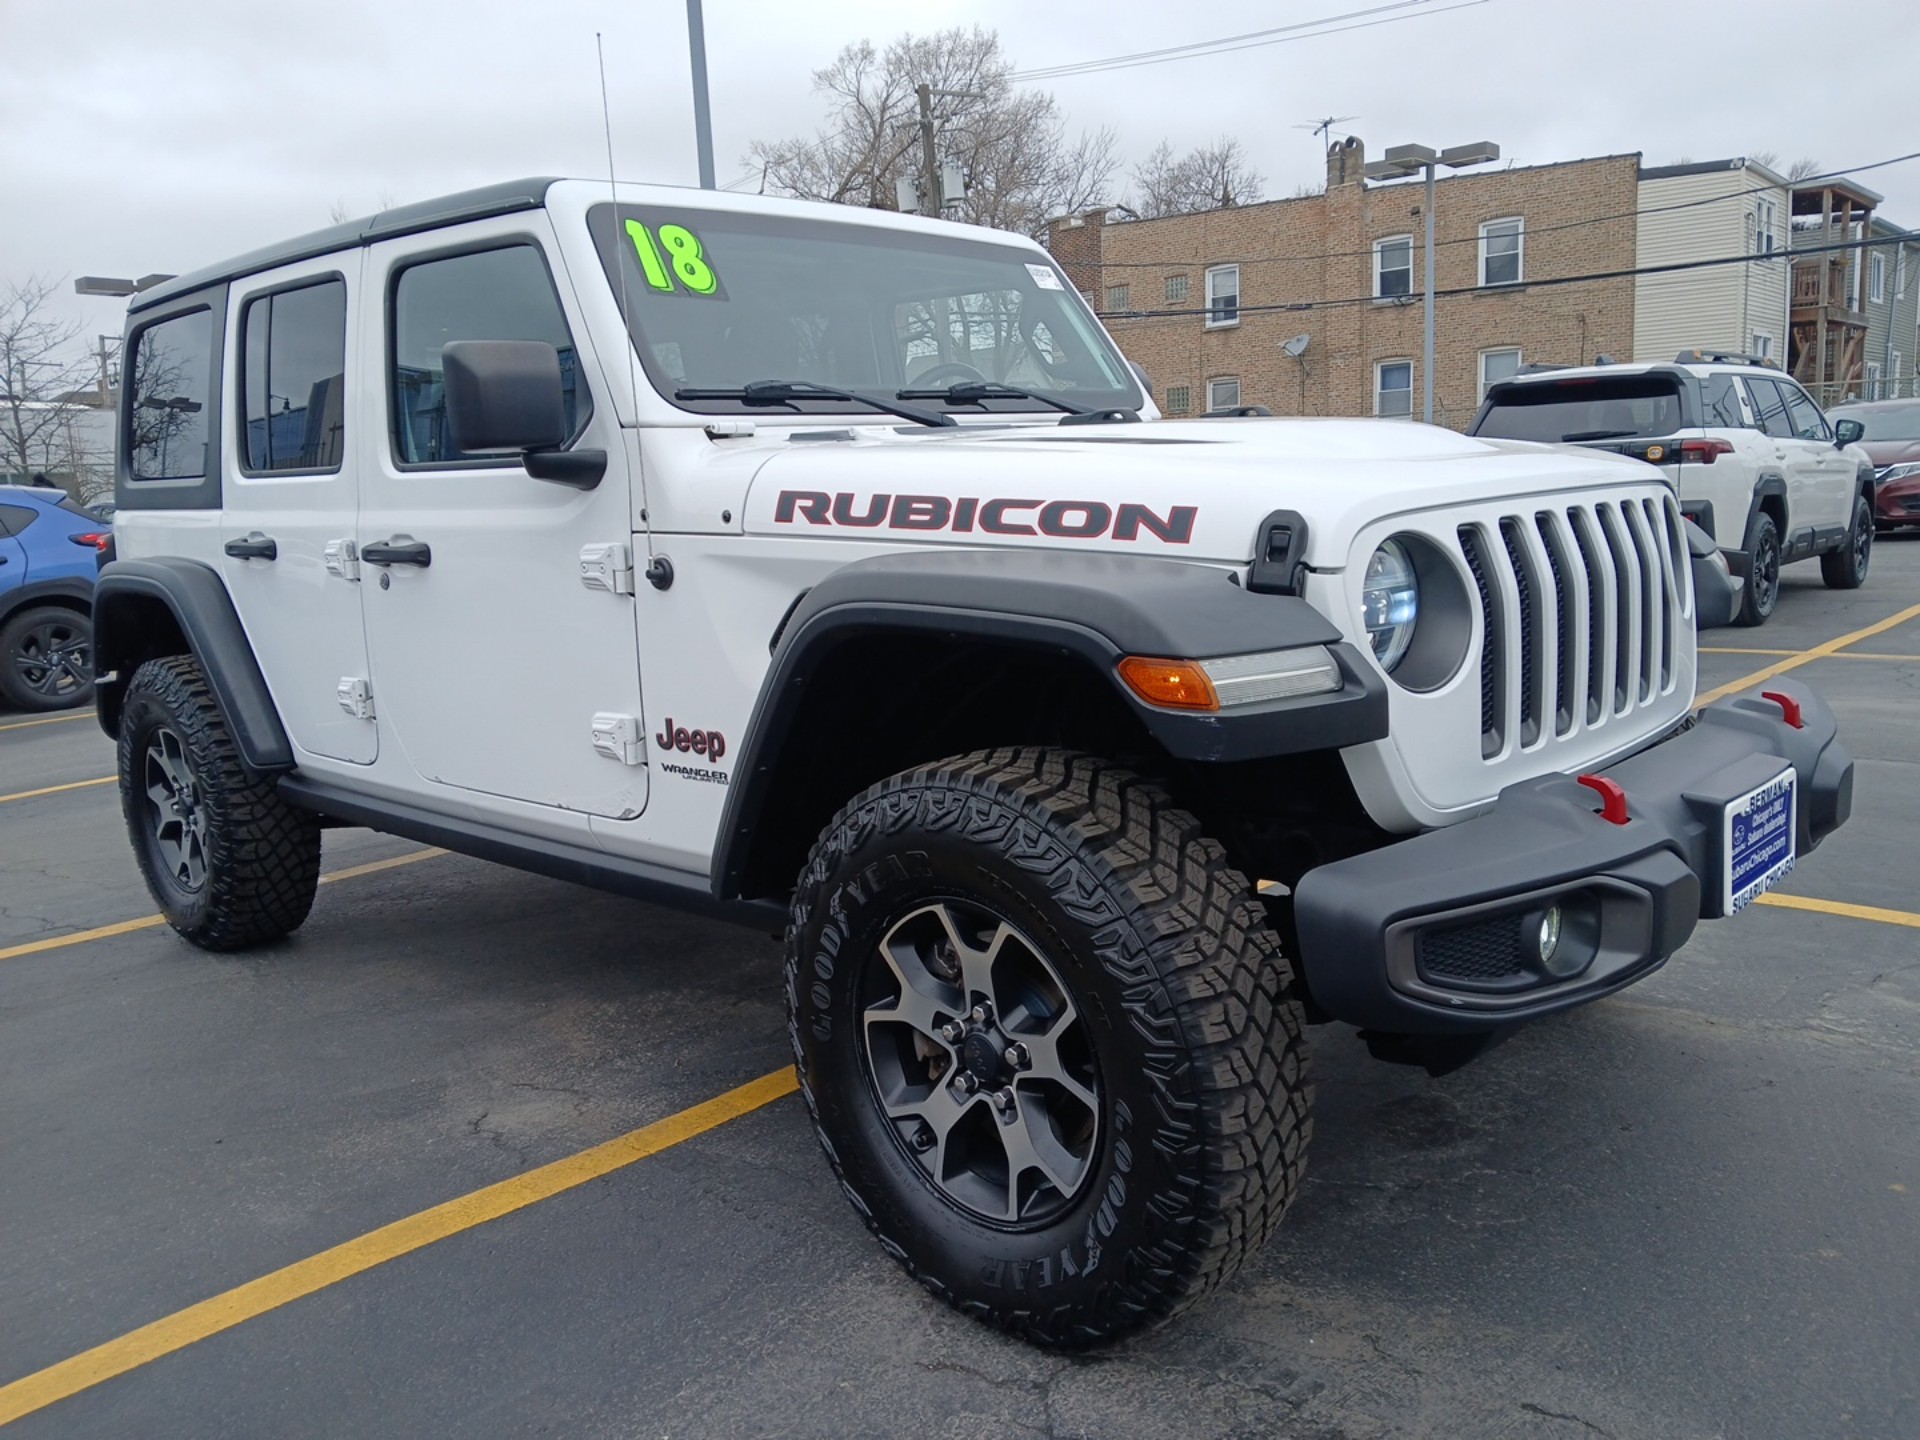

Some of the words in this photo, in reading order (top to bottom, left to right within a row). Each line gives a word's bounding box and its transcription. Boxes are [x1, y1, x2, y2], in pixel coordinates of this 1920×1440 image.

[624, 218, 718, 295] 18
[774, 490, 1199, 544] RUBICON
[656, 717, 726, 763] Jeep
[661, 762, 728, 780] WRANGLER
[682, 774, 729, 785] UNLIMITED
[811, 850, 934, 1042] GOODYEAR
[979, 1098, 1133, 1290] GOODYEAR
